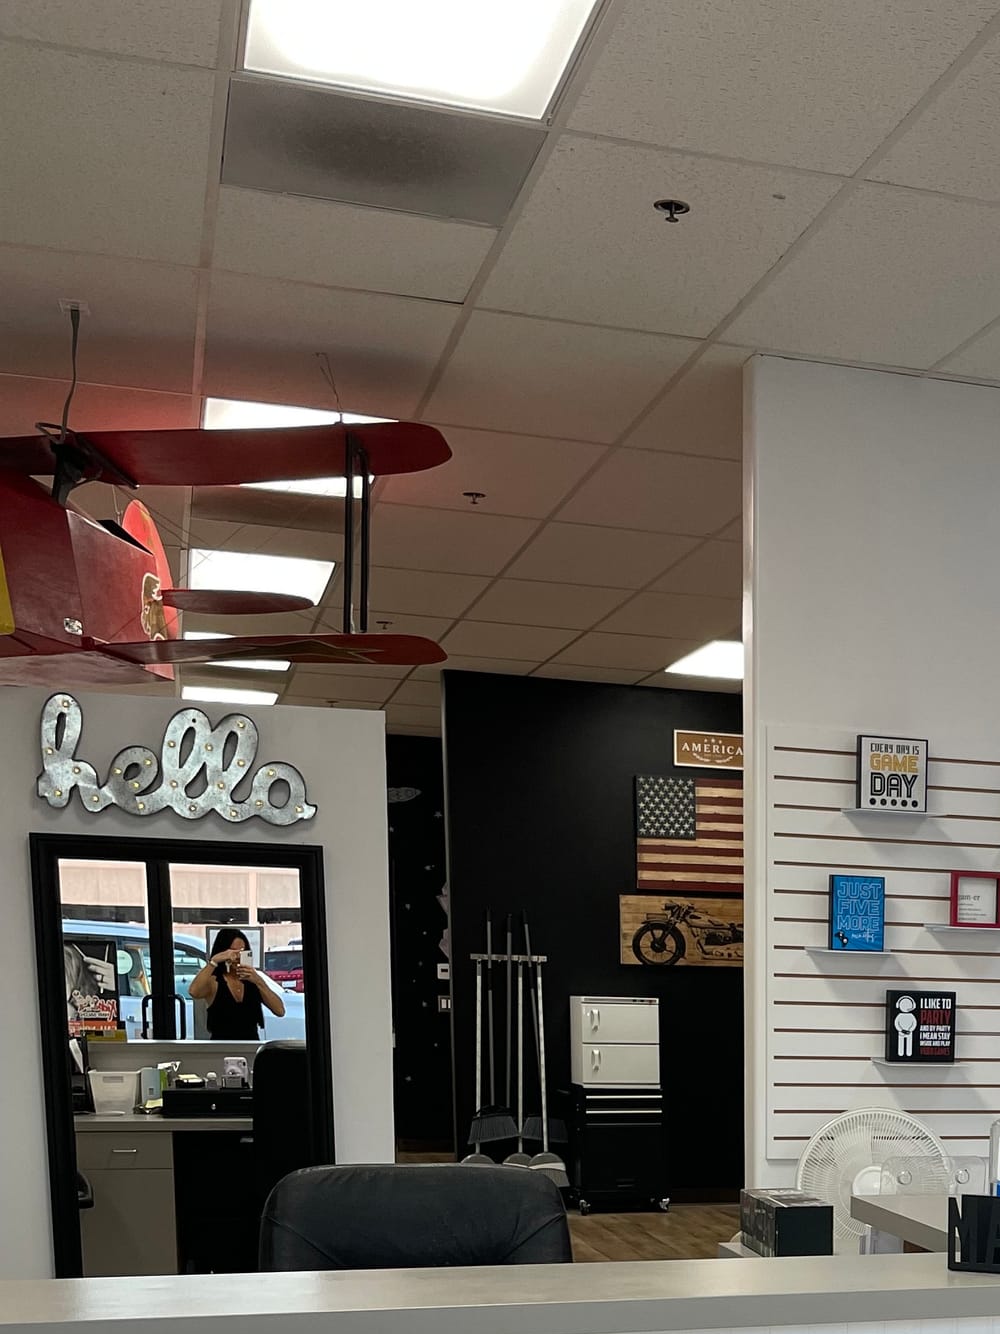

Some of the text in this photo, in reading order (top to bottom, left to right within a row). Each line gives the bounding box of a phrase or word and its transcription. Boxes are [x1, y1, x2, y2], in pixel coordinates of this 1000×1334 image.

[681, 742, 743, 756] AMERICA
[870, 743, 893, 753] EVERY
[912, 745, 920, 755] IS
[36, 692, 318, 826] hello
[870, 752, 919, 773] GAME
[870, 772, 919, 798] DAY
[837, 882, 881, 899] JUST
[838, 898, 880, 916] FIVE
[837, 915, 880, 931] MORE
[920, 998, 952, 1009] I LIKE TO
[920, 1009, 950, 1025] PARTY
